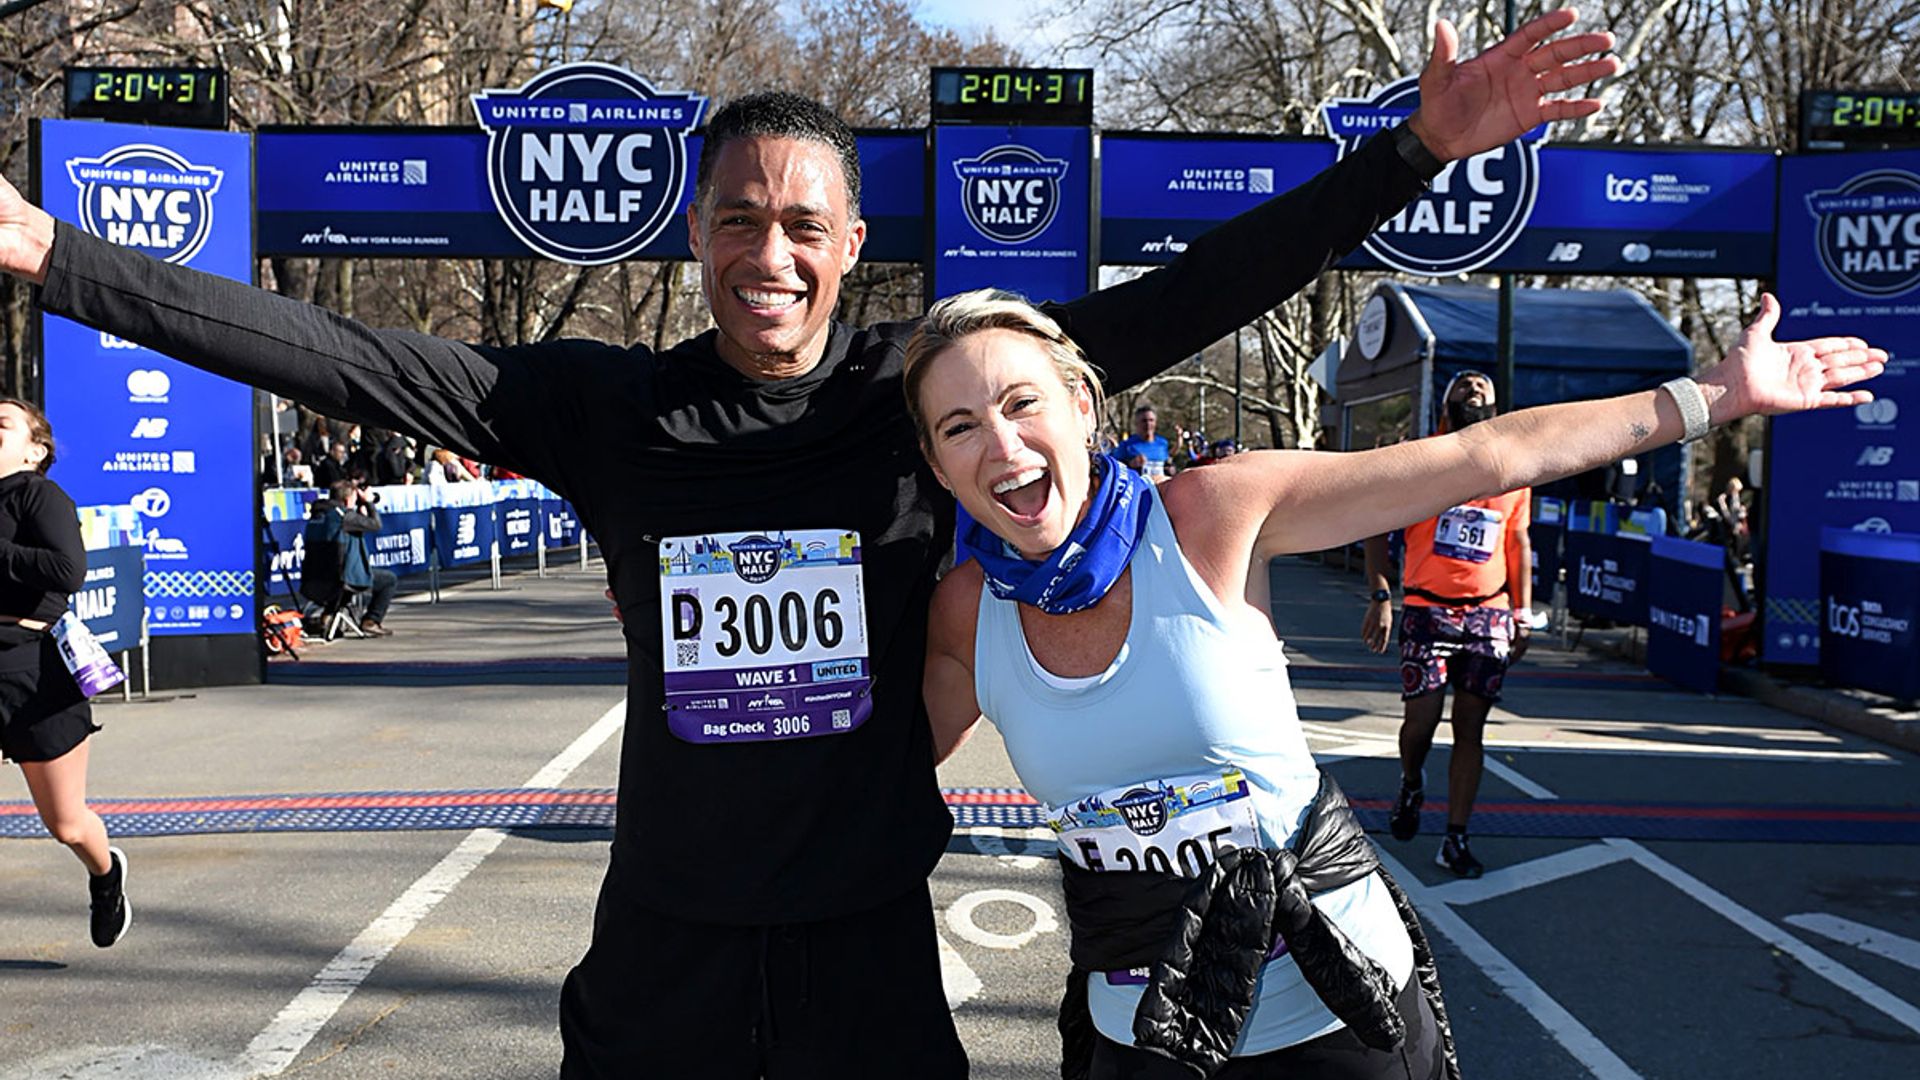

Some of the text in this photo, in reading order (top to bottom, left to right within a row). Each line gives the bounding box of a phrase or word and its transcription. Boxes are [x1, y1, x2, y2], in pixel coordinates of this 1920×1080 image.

[492, 106, 683, 120] UNITED AIRLINES
[1342, 115, 1408, 128] UNITE
[339, 161, 400, 172] UNITED
[521, 132, 653, 183] NYC
[80, 168, 210, 186] UNITED AIRLINES
[325, 172, 400, 183] AIRLINES
[963, 166, 1058, 174] UNITED AIRLINES
[1183, 169, 1245, 180] UNITED
[977, 179, 1044, 205] NYC
[1168, 180, 1245, 191] AIRLINES
[1606, 173, 1648, 202] tcs
[101, 186, 191, 224] NYC
[530, 189, 642, 223] HALF
[982, 207, 1039, 224] HALF
[107, 221, 185, 249] HALF
[1837, 212, 1920, 248] NYC
[1843, 249, 1920, 273] HALF
[376, 533, 410, 551] UNITED
[1458, 524, 1486, 546] 561
[369, 549, 411, 567] AIRLINES
[739, 551, 774, 565] NYC
[742, 564, 771, 575] HALF
[75, 586, 117, 620] HALF
[672, 593, 703, 640] D
[714, 588, 843, 657] 3006
[735, 668, 797, 686] WAVE 1
[817, 664, 857, 677] UNITED
[703, 715, 810, 736] Bag Check 3006
[1125, 802, 1160, 819] NYC
[1131, 816, 1159, 828] HALF
